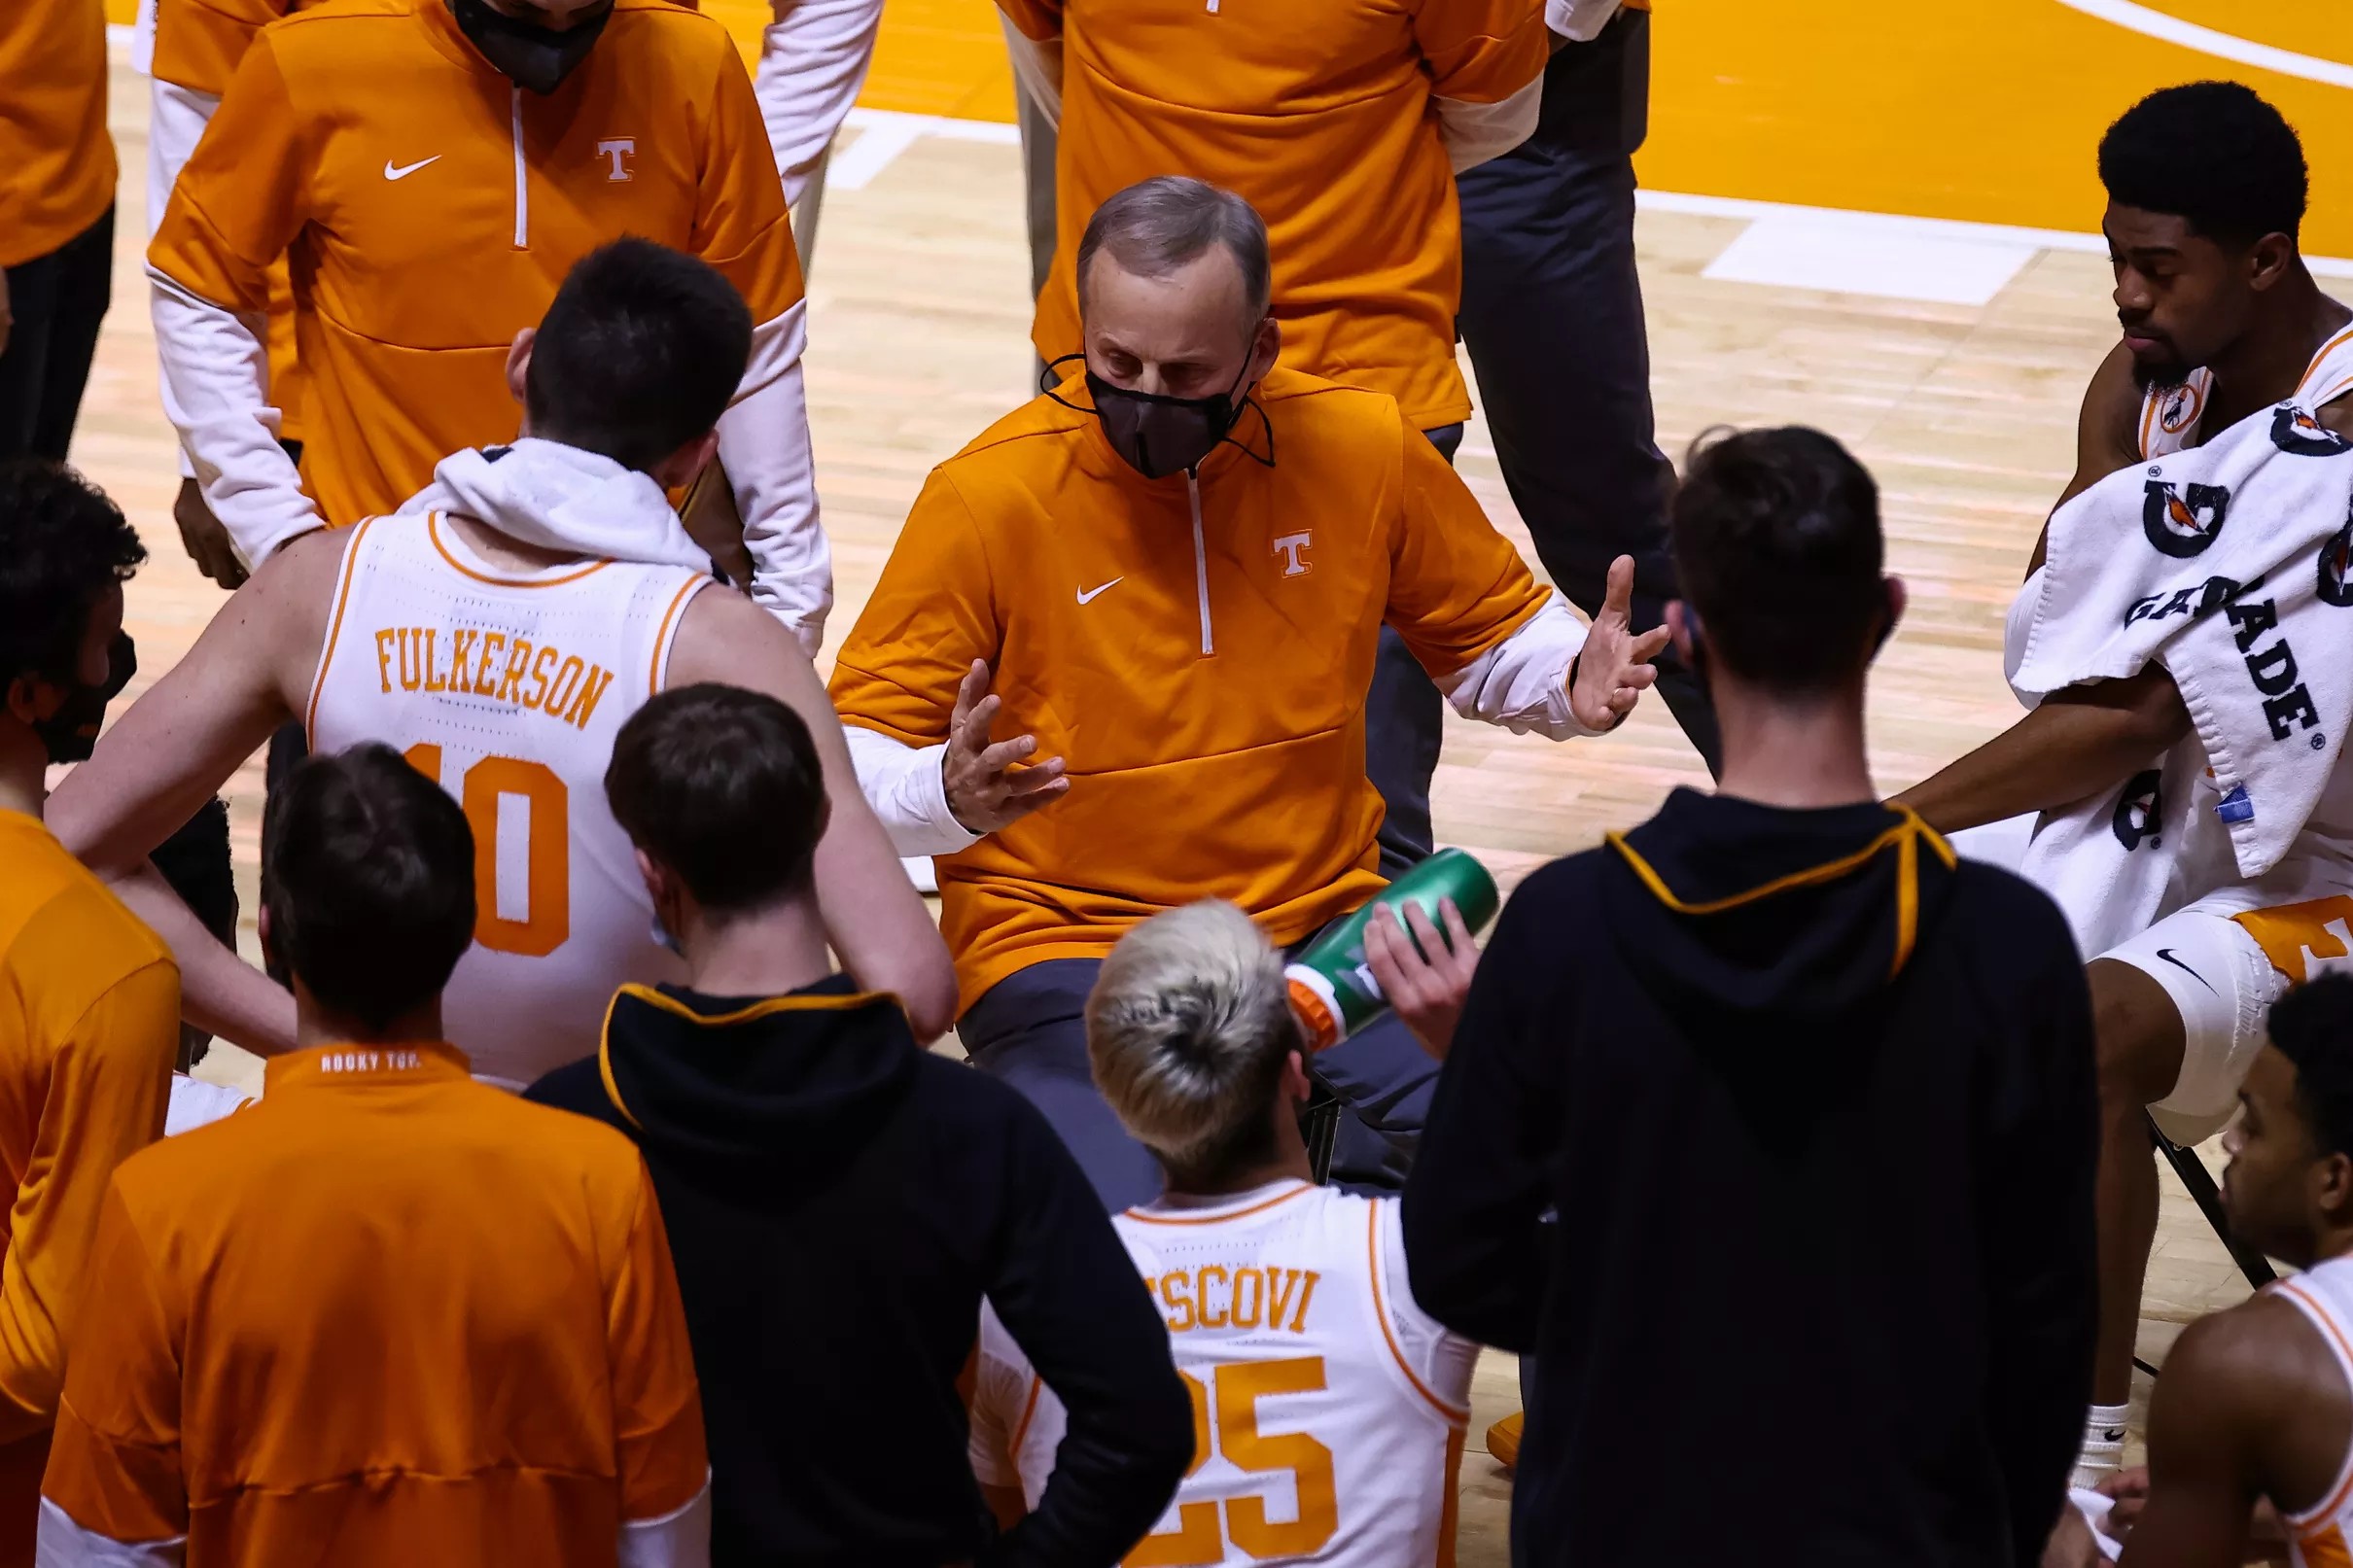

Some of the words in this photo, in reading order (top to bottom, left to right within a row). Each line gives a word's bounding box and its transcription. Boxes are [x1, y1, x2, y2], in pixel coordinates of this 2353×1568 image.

[596, 137, 635, 182] T
[1273, 530, 1312, 576] T
[375, 627, 615, 731] FULKERSON
[403, 743, 570, 958] 0
[1145, 1266, 1321, 1334] SCOVI
